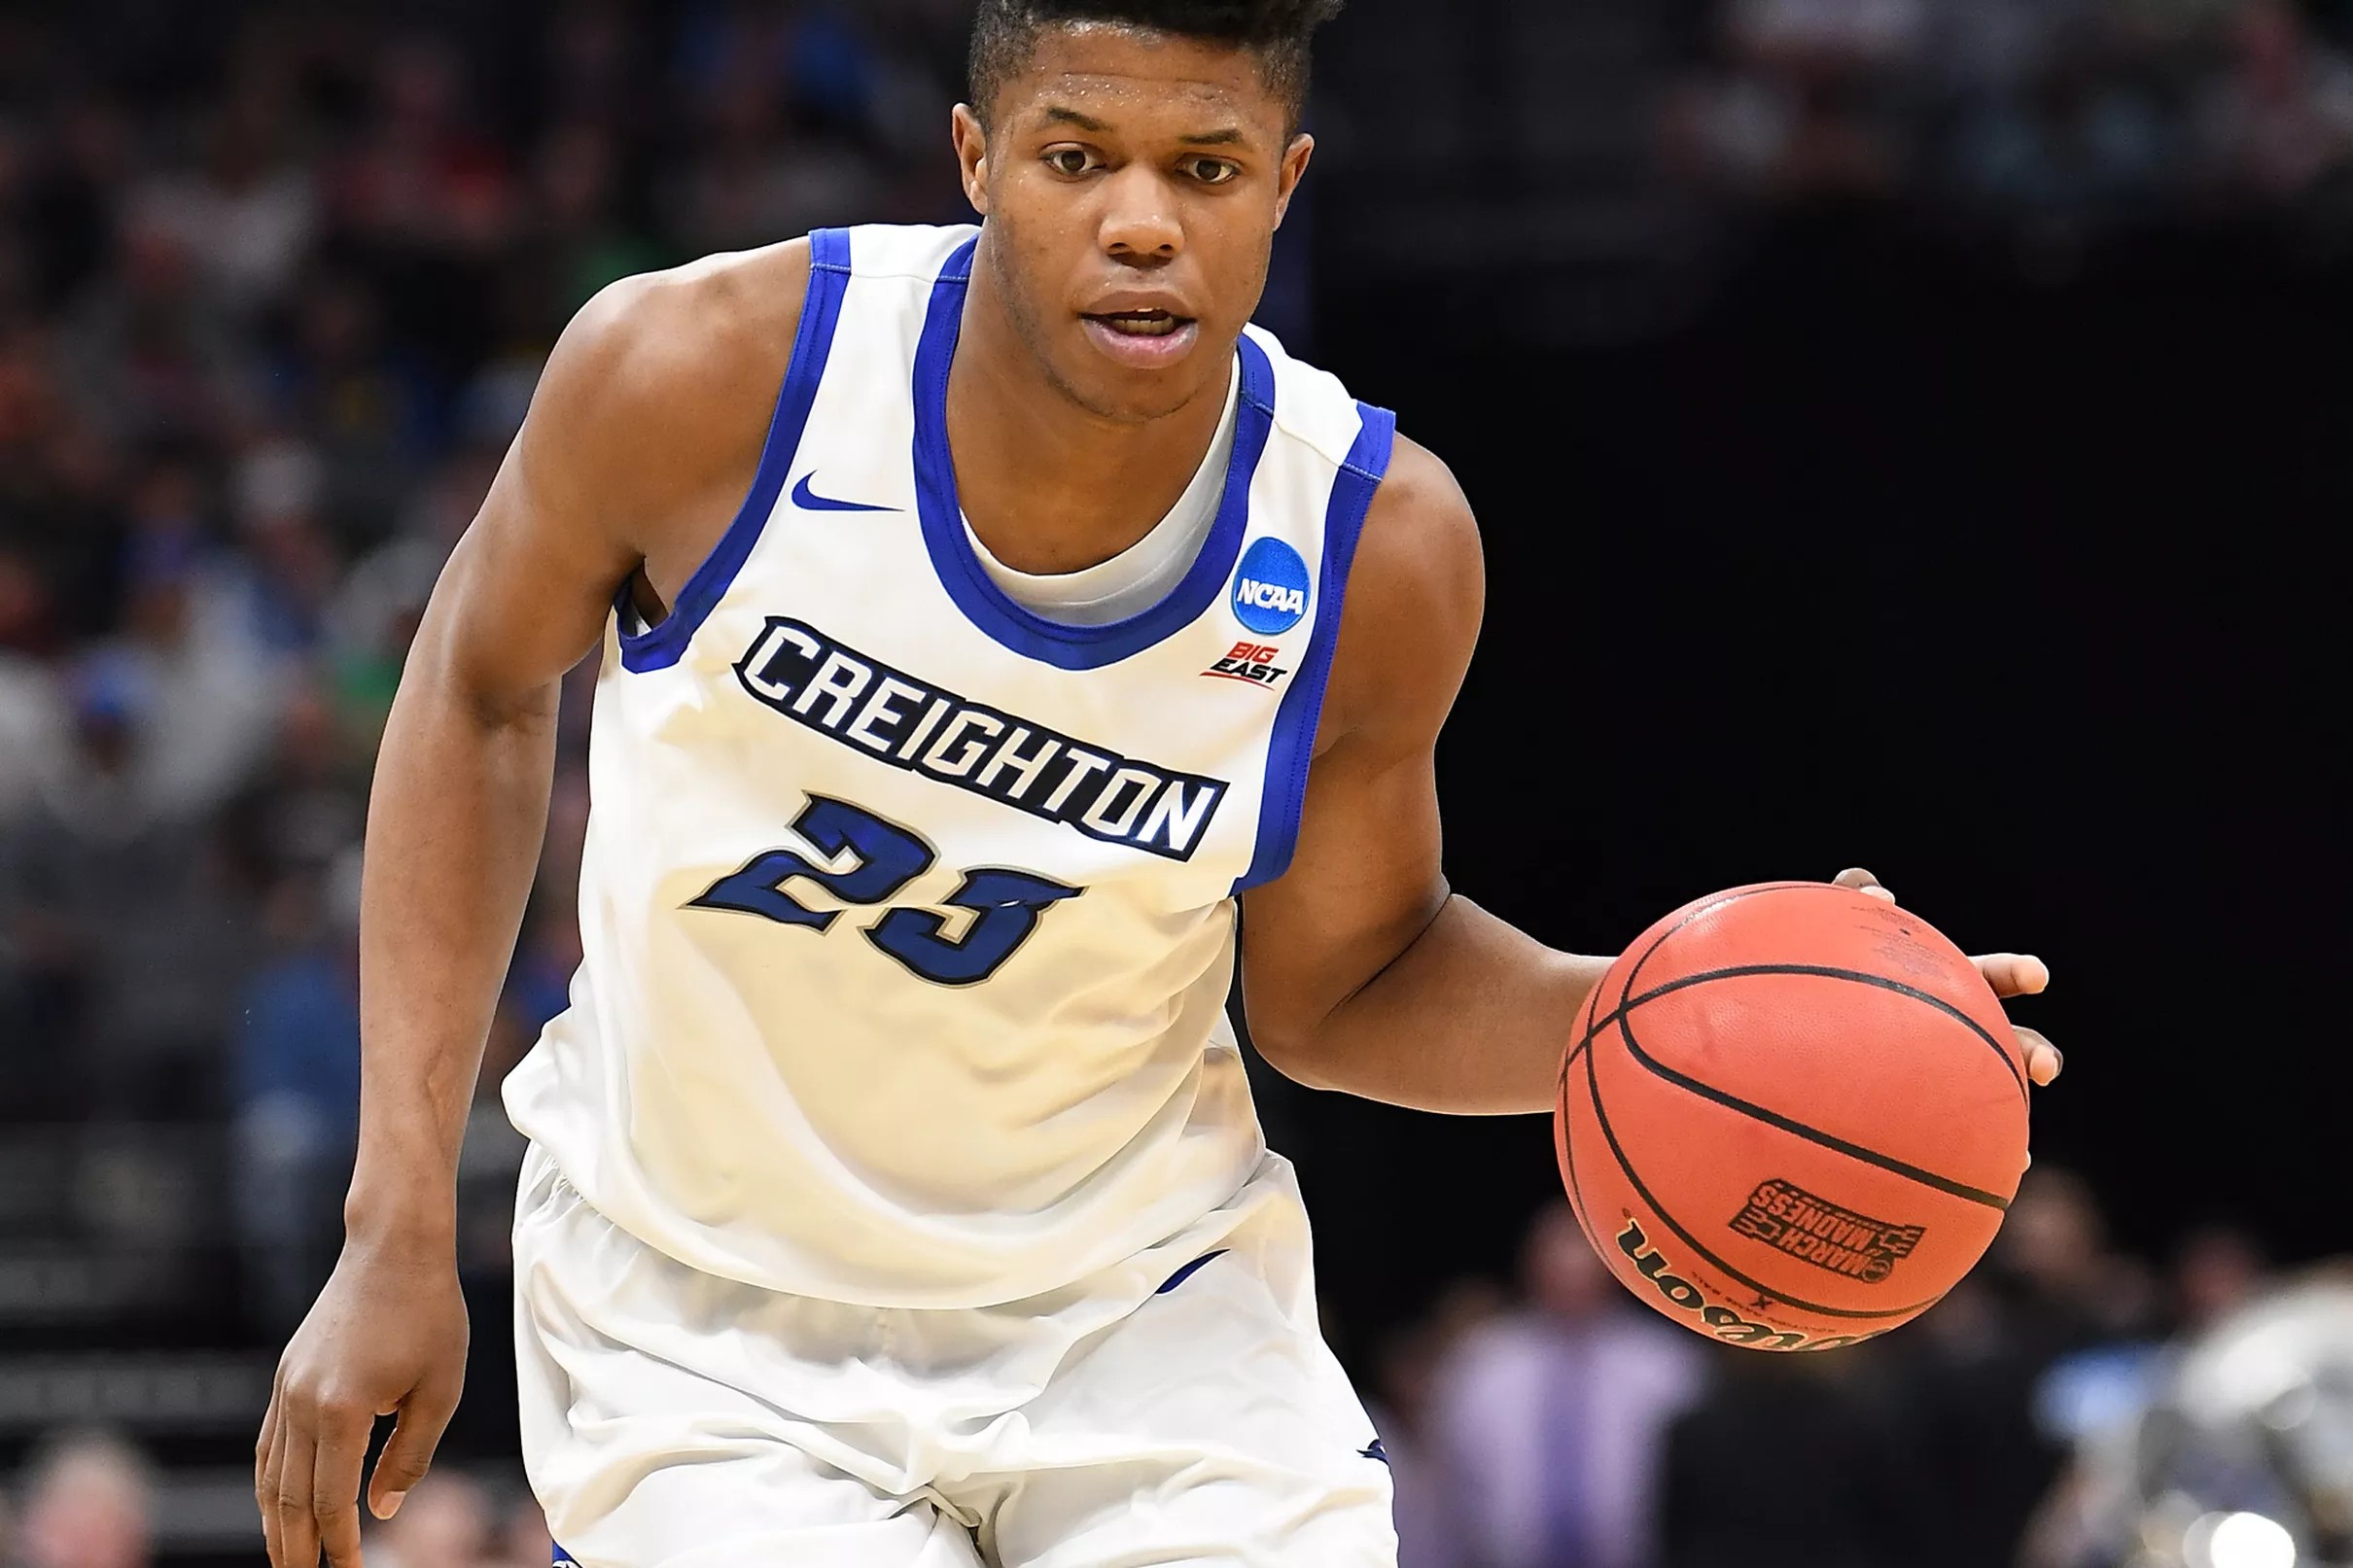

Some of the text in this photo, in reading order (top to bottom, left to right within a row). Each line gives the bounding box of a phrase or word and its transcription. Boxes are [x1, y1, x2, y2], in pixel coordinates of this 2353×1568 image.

[1236, 577, 1305, 615] NCAA
[1209, 657, 1288, 683] EAST
[1225, 641, 1280, 664] BIG
[743, 624, 1216, 852] CREIGHTON
[679, 790, 1087, 989] 23
[1750, 1183, 1878, 1252] MADNESS
[1775, 1227, 1872, 1275] MARCH
